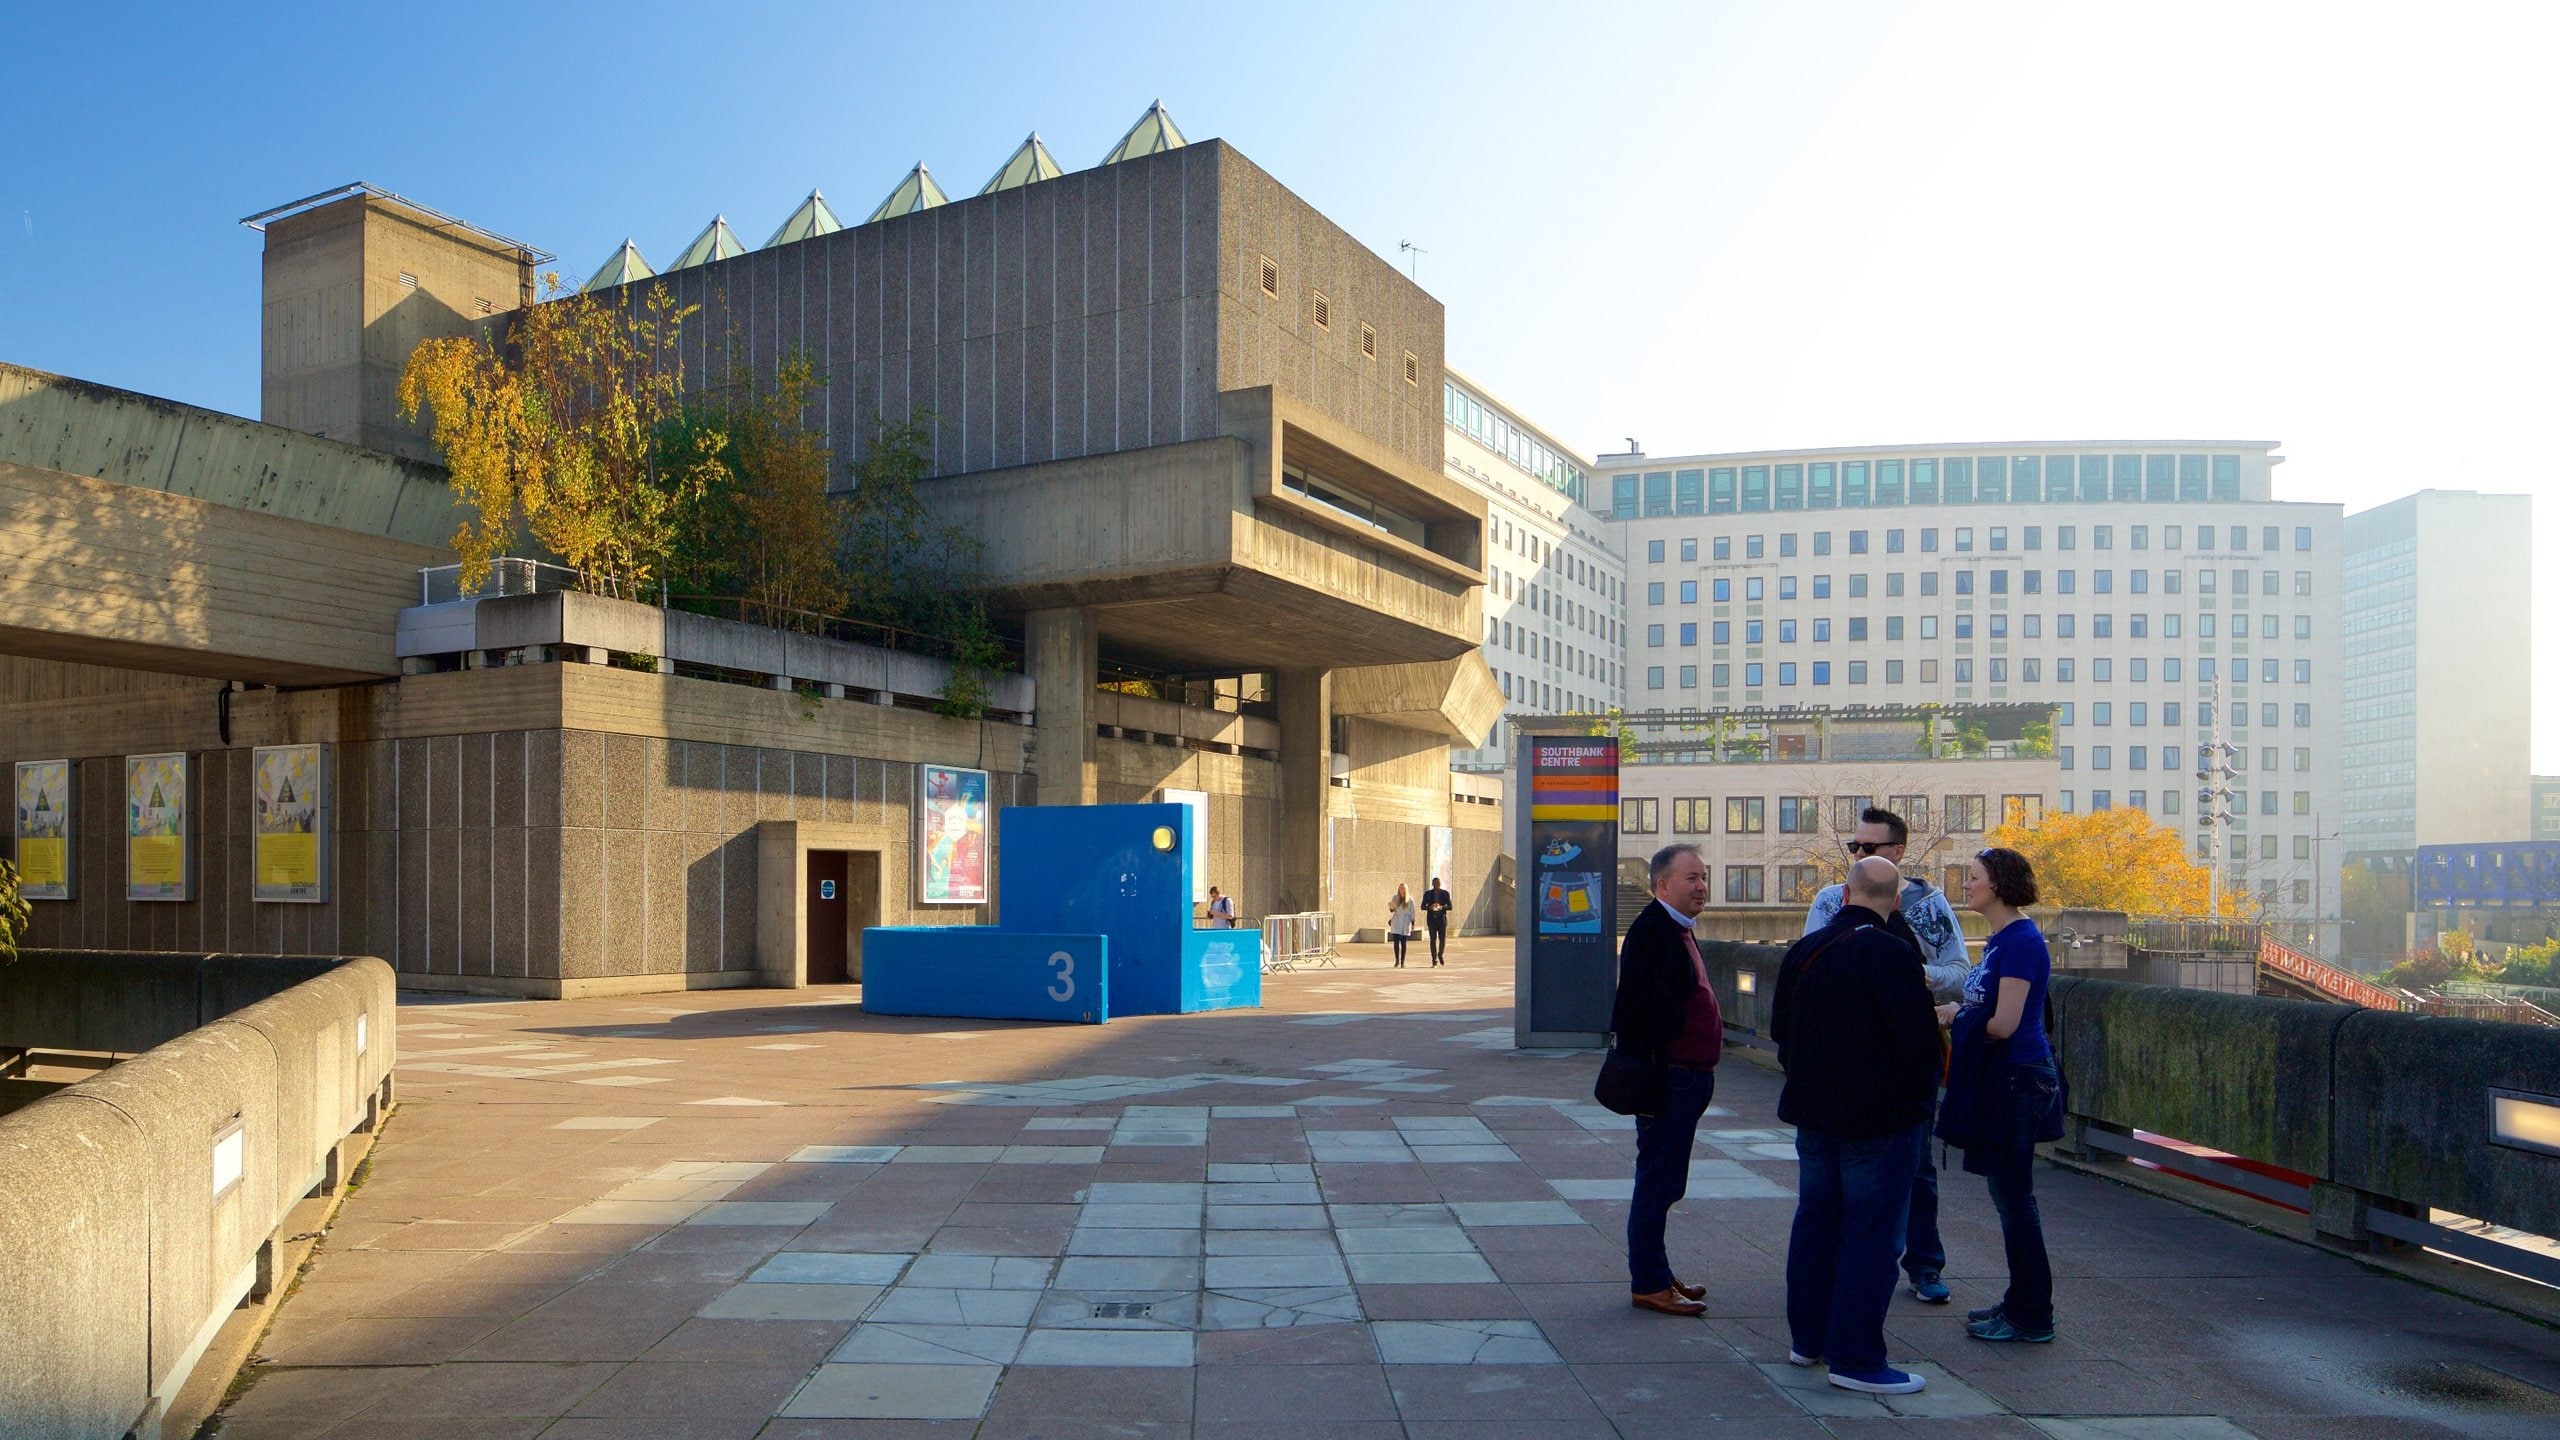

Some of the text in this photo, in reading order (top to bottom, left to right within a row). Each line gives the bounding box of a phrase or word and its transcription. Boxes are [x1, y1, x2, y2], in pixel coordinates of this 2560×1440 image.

[1541, 747, 1604, 757] SOUTHBANK
[1541, 757, 1581, 767] CENTRE
[1047, 950, 1075, 1003] 3
[2280, 950, 2354, 994] MARKET
